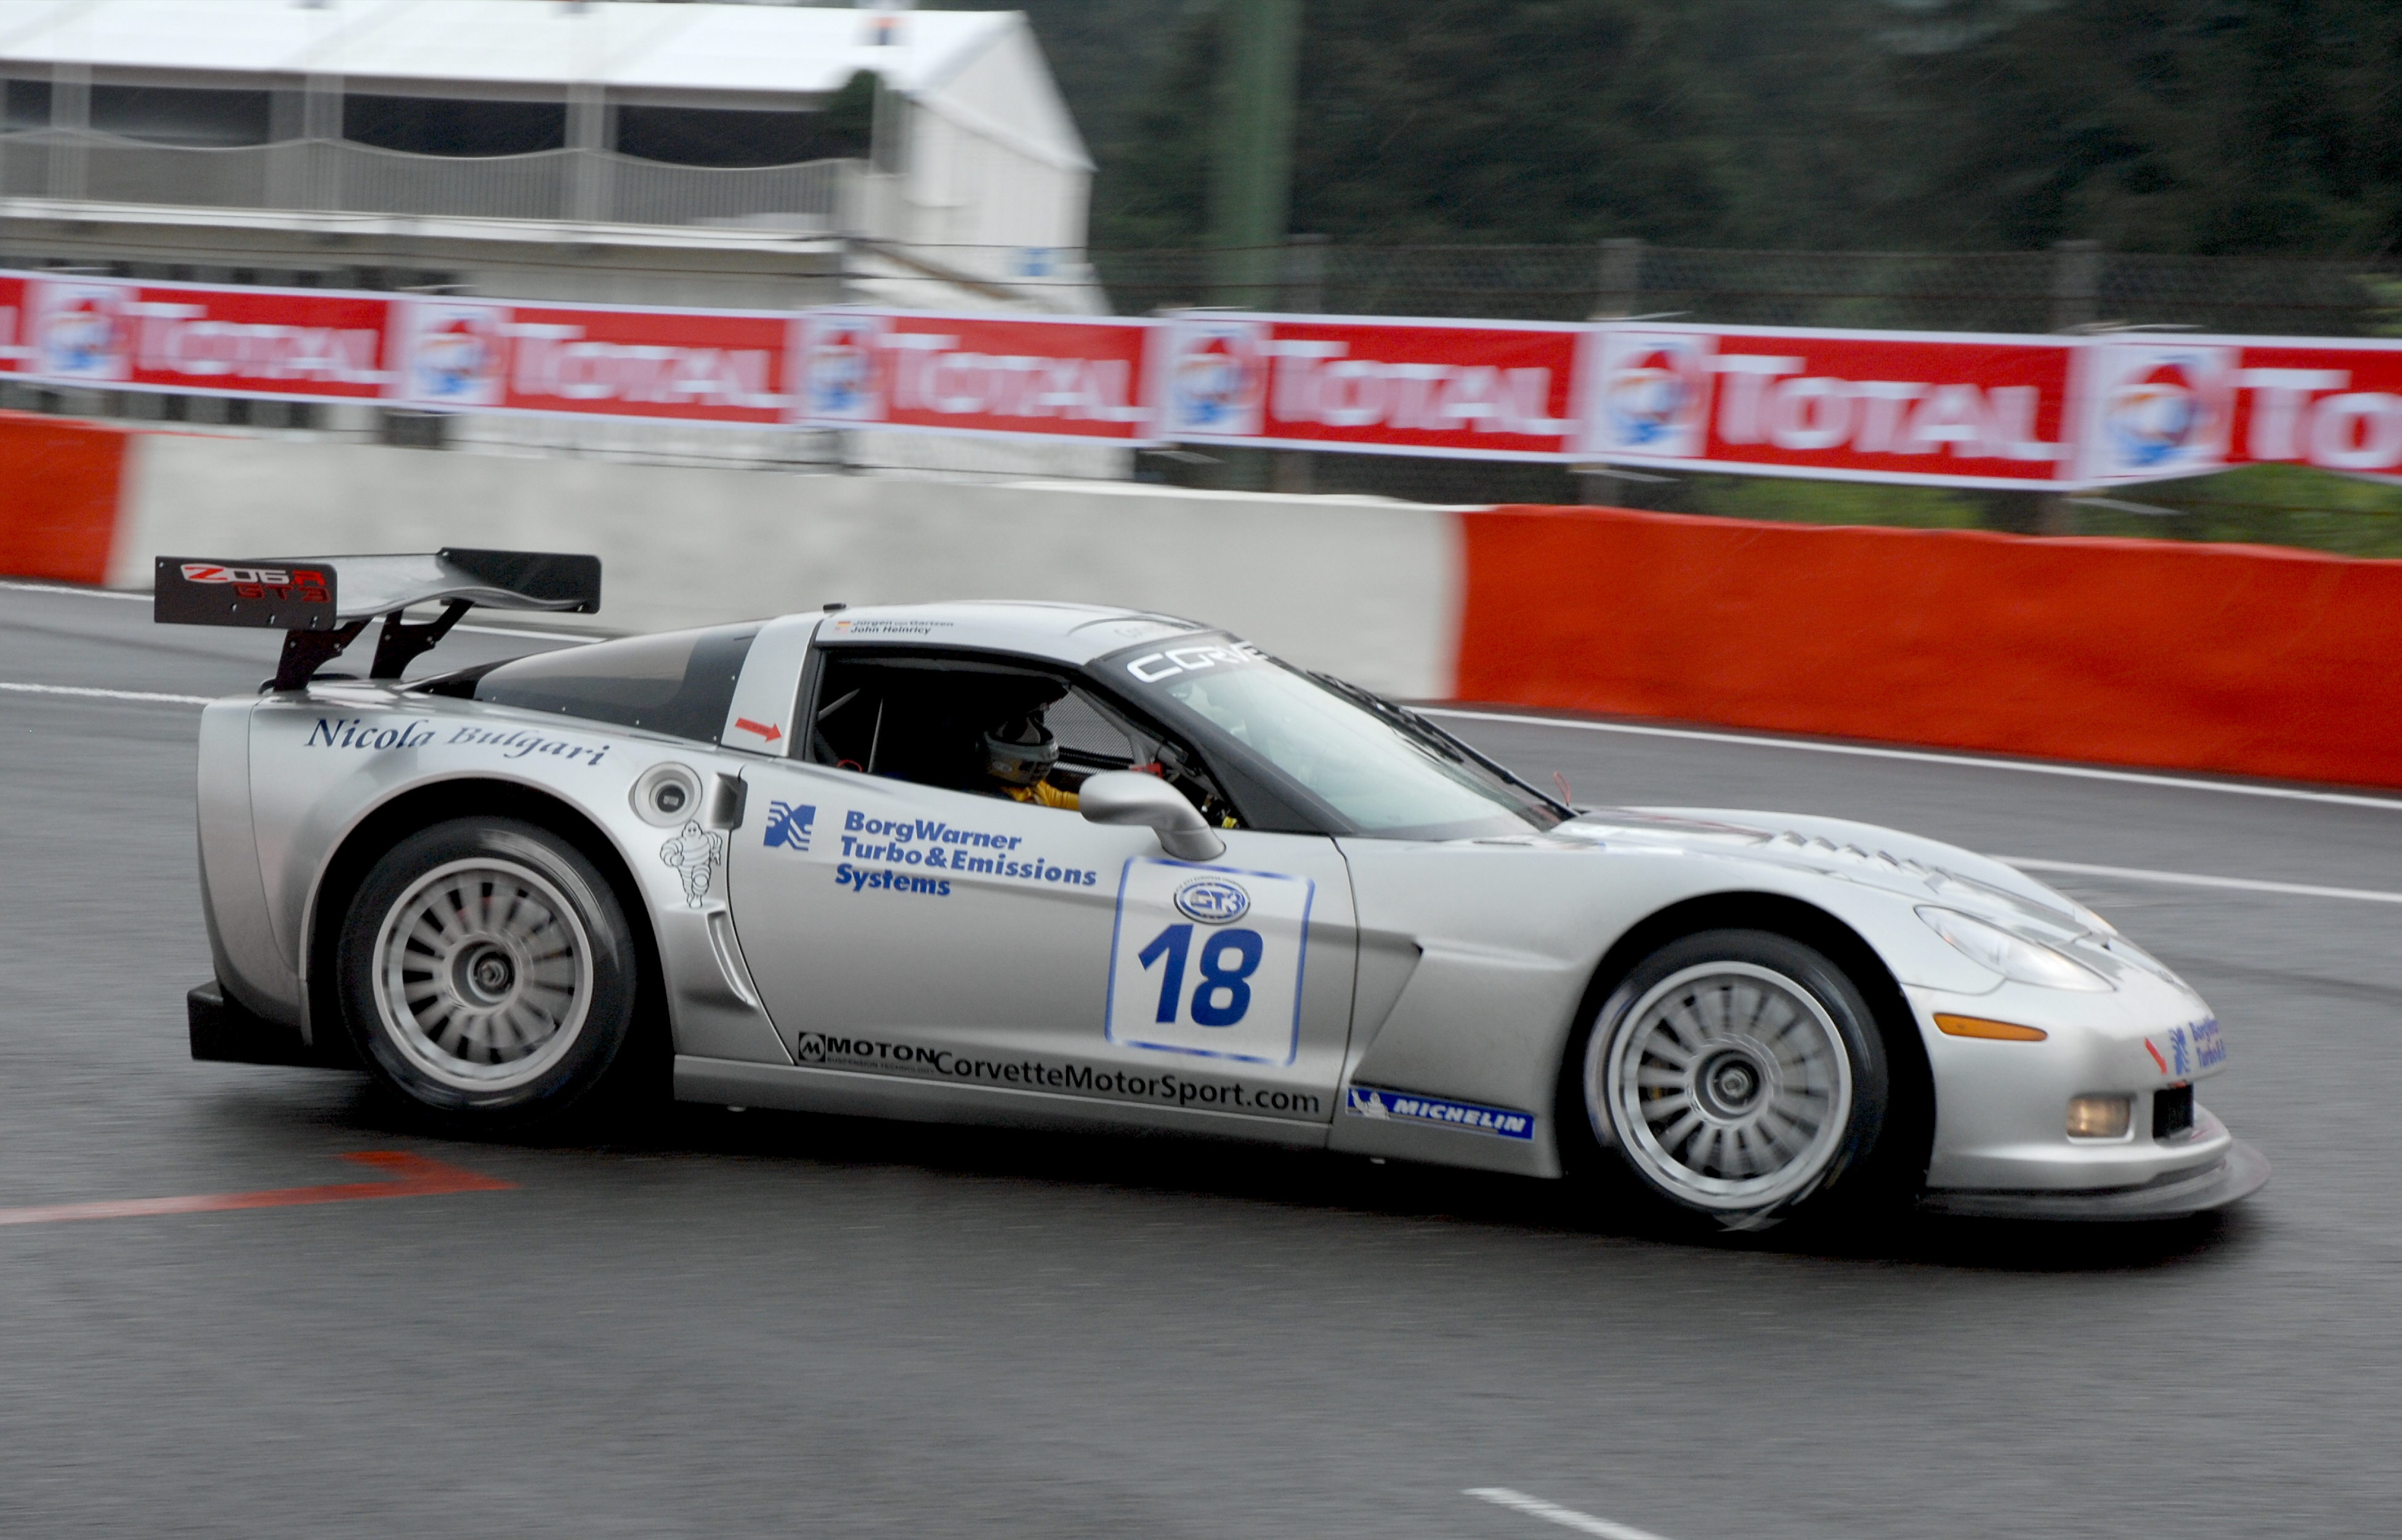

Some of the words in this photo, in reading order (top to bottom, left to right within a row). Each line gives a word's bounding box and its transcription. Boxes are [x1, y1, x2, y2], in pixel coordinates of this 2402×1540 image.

[1256, 339, 1582, 436] TOTAL
[1705, 354, 2072, 461] TOTAL
[851, 626, 880, 634] John
[304, 718, 436, 751] Nicola
[443, 726, 611, 767] Bulgari
[844, 810, 1022, 851] BorgWarner
[835, 863, 952, 897] Systems
[1138, 923, 1264, 1028] 18
[827, 1037, 936, 1063] MOTON
[935, 1050, 1320, 1114] CorvetteMotorSport.com
[1393, 1099, 1527, 1132] MICHELIN
